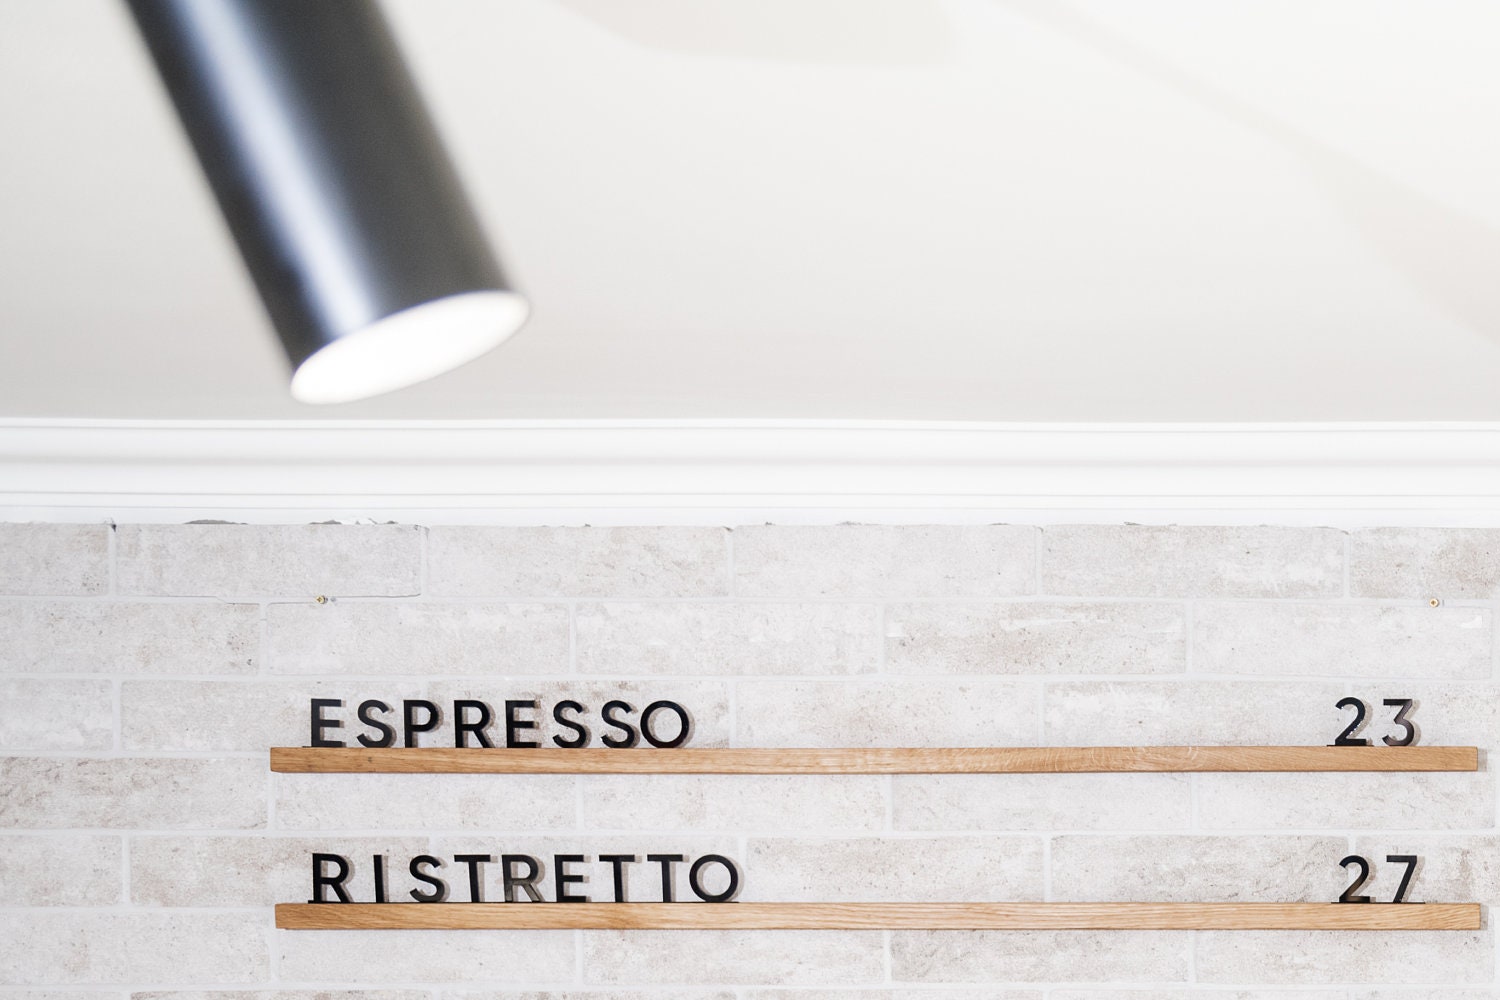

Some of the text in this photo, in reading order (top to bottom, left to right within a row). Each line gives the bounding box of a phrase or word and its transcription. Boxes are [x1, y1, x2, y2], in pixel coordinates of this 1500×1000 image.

[310, 697, 1416, 749] ESPRESSO 23
[312, 852, 1427, 904] RISTRETTO 27
